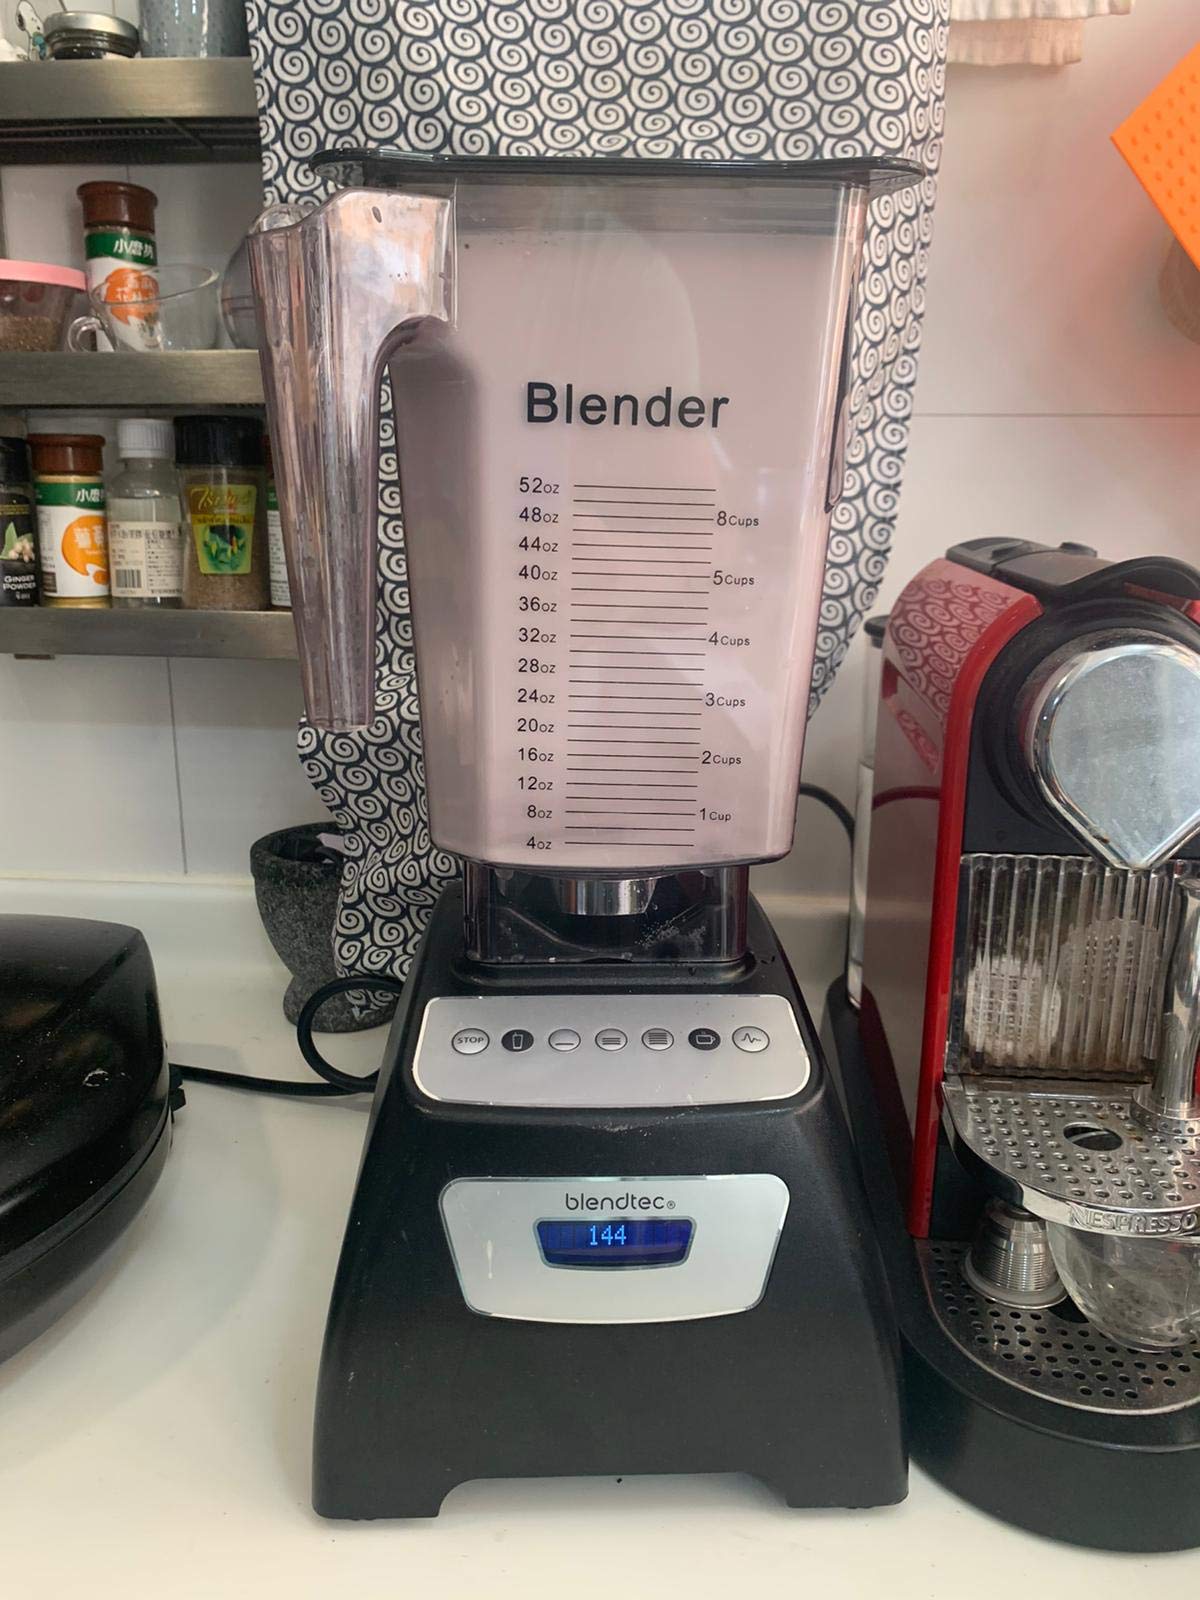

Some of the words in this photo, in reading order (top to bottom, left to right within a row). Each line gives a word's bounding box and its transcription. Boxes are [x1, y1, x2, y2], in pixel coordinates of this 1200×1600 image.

[526, 382, 730, 428] Blender
[519, 476, 560, 494] 52oz
[519, 506, 559, 523] 48oz
[519, 535, 559, 552] 44oz
[4, 575, 35, 583] GINGER
[518, 564, 559, 581] 40oz
[3, 582, 36, 590] POWDER
[519, 595, 558, 612] 36oz
[518, 626, 557, 643] 32oz
[518, 657, 557, 673] 28oz
[517, 687, 556, 704] 24oz
[517, 717, 555, 733] 20oz
[518, 746, 555, 762] 16oz
[518, 775, 554, 790] 12oz
[527, 804, 553, 818] 8oz
[526, 835, 552, 850] 4oz
[457, 1036, 484, 1044] STOP
[1070, 1203, 1198, 1233] NESPRESSO
[589, 1224, 627, 1246] 144
